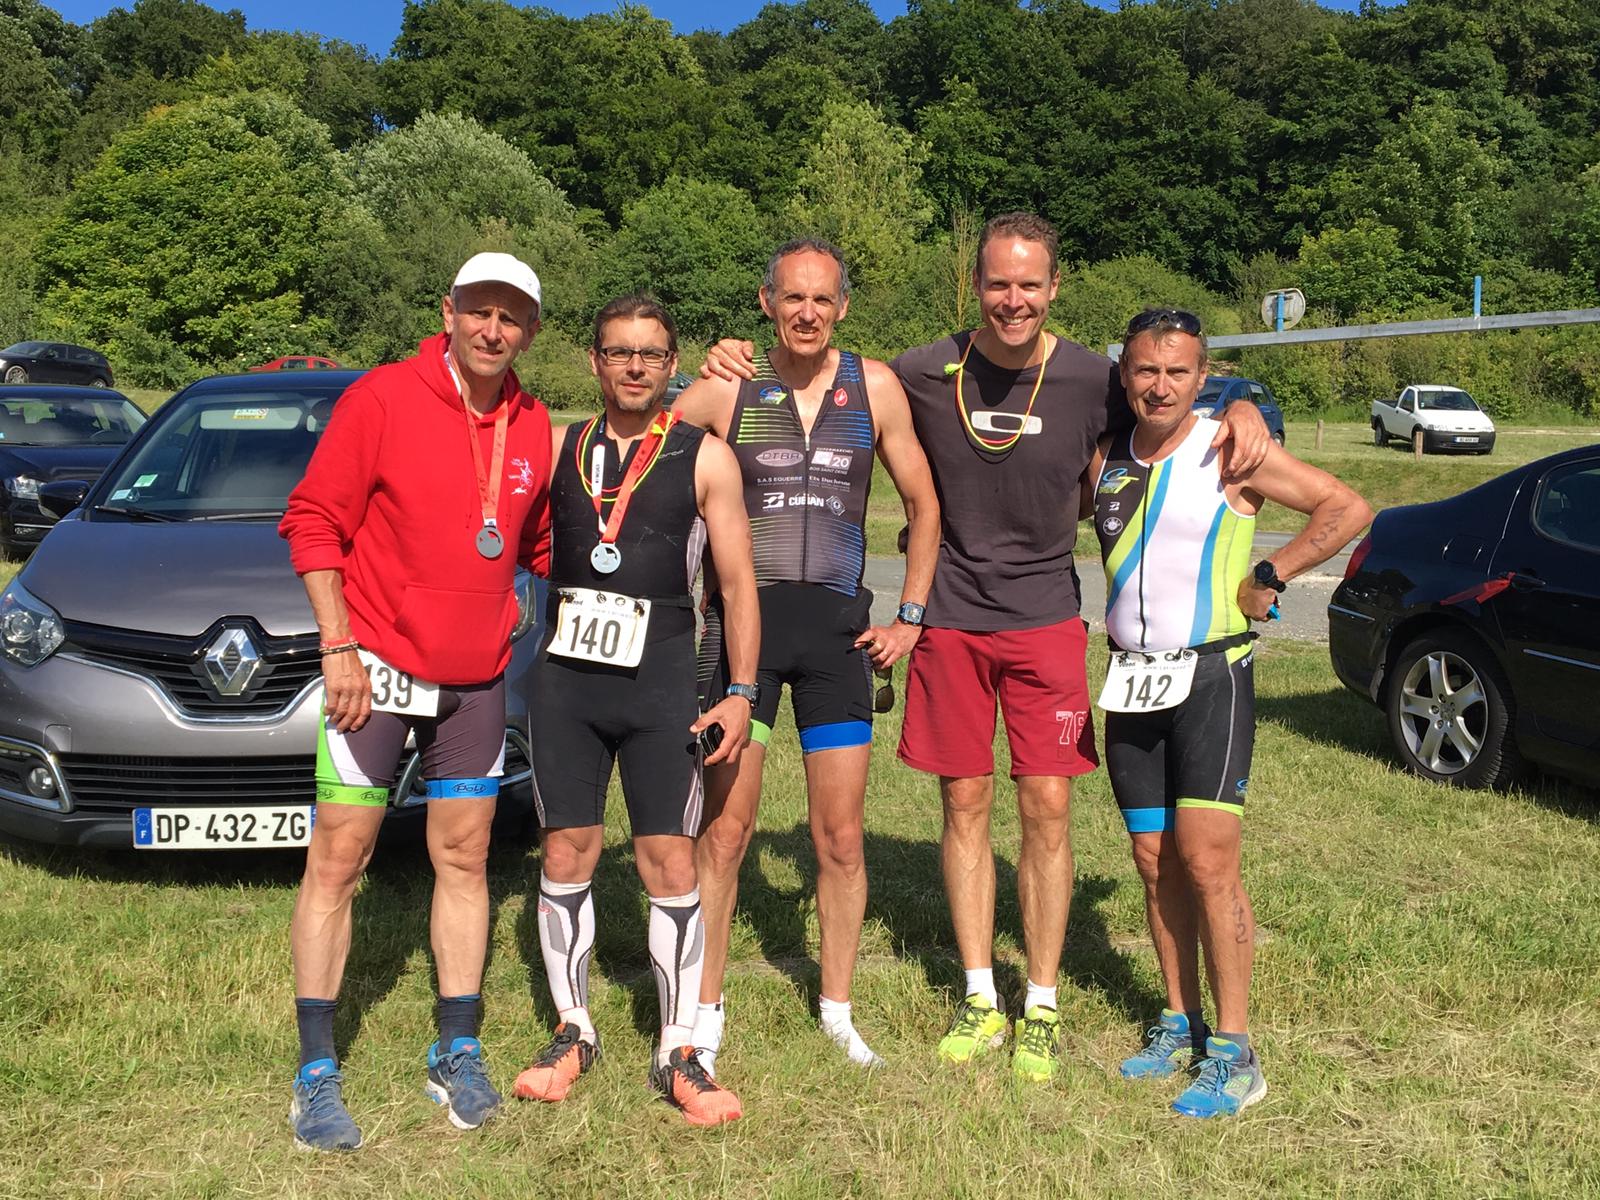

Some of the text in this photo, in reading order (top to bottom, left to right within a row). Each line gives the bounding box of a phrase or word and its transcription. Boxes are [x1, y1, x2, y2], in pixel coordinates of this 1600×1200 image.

[831, 456, 849, 468] 20
[570, 614, 621, 659] 140
[1123, 674, 1172, 708] 142
[140, 830, 147, 839] F
[156, 812, 306, 843] DP-432-ZG
